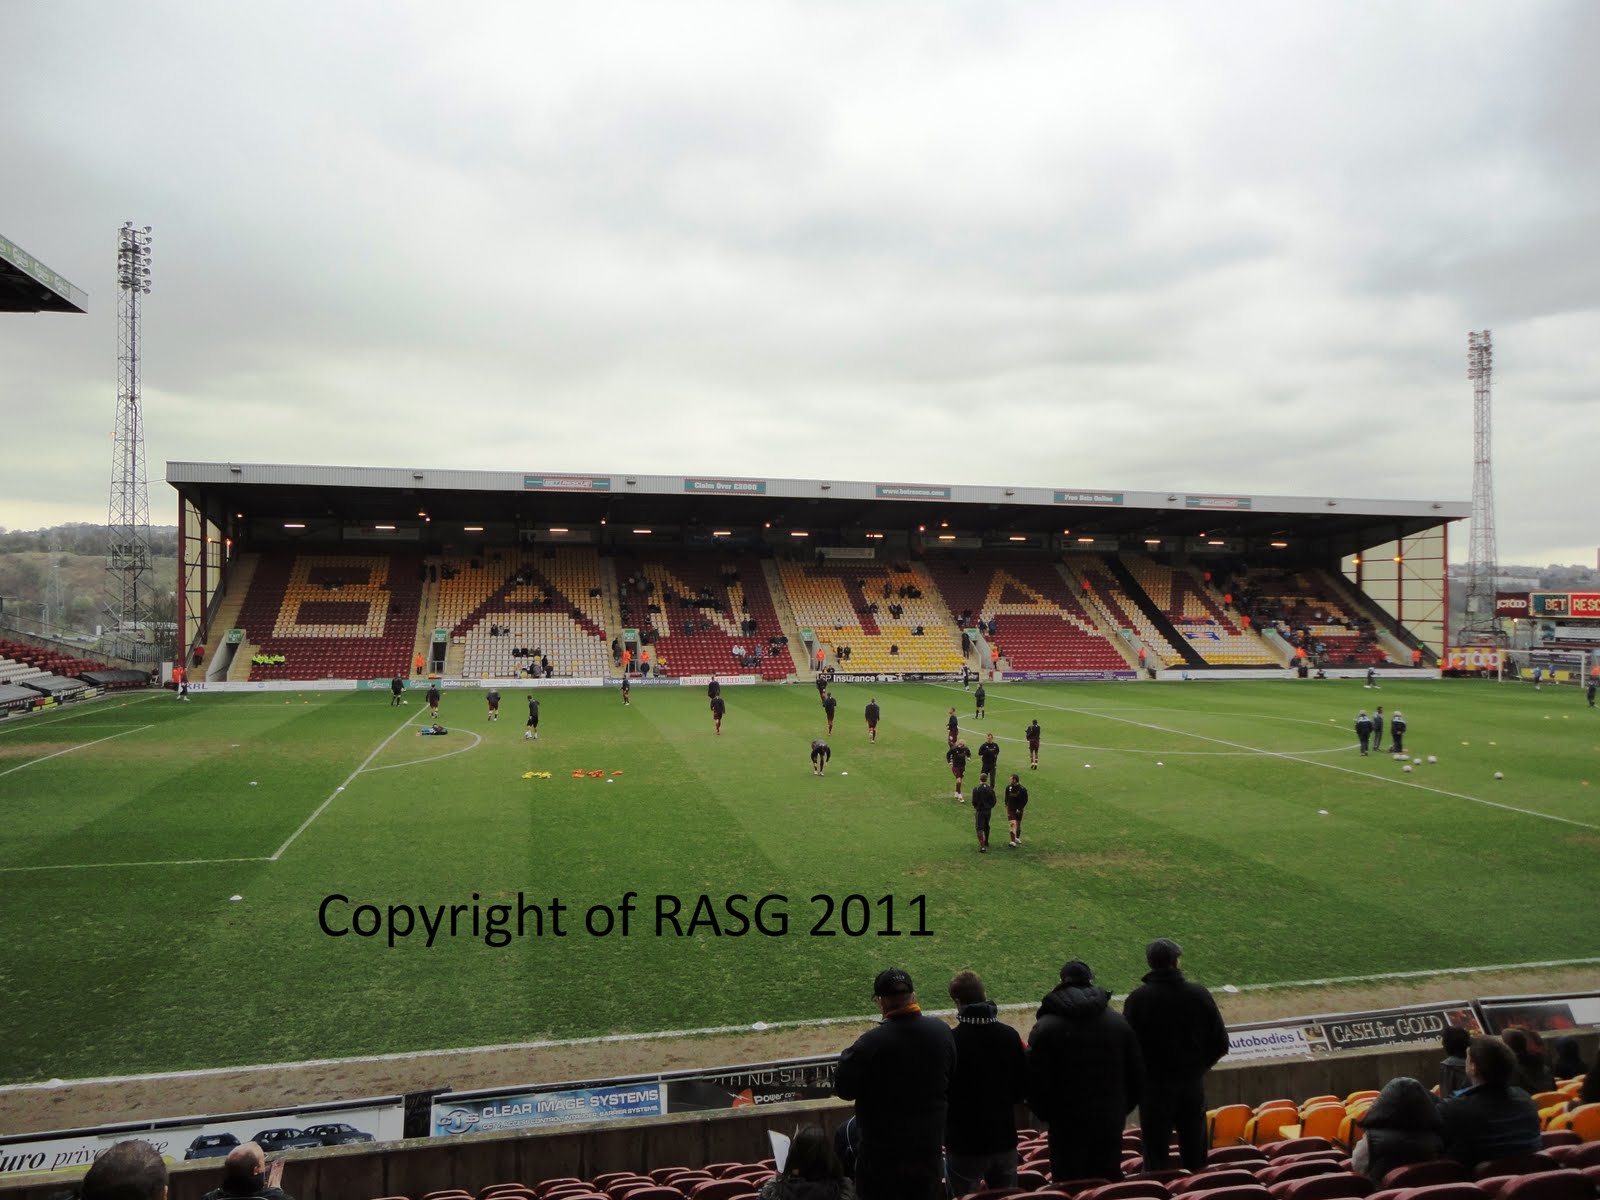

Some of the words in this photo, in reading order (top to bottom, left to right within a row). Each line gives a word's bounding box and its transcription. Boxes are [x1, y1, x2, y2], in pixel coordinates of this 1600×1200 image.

[1544, 598, 1567, 611] BET
[833, 674, 876, 683] Insurance
[1331, 1022, 1379, 1043] CASH
[1376, 1020, 1396, 1038] for
[1396, 1015, 1444, 1036] GOLD
[748, 1071, 774, 1086] NO
[482, 1103, 533, 1119] CLEAR
[537, 1097, 586, 1114] IMAGE
[589, 1089, 660, 1108] SYSTEMS
[0, 1150, 46, 1172] uro
[51, 1145, 109, 1172] priv
